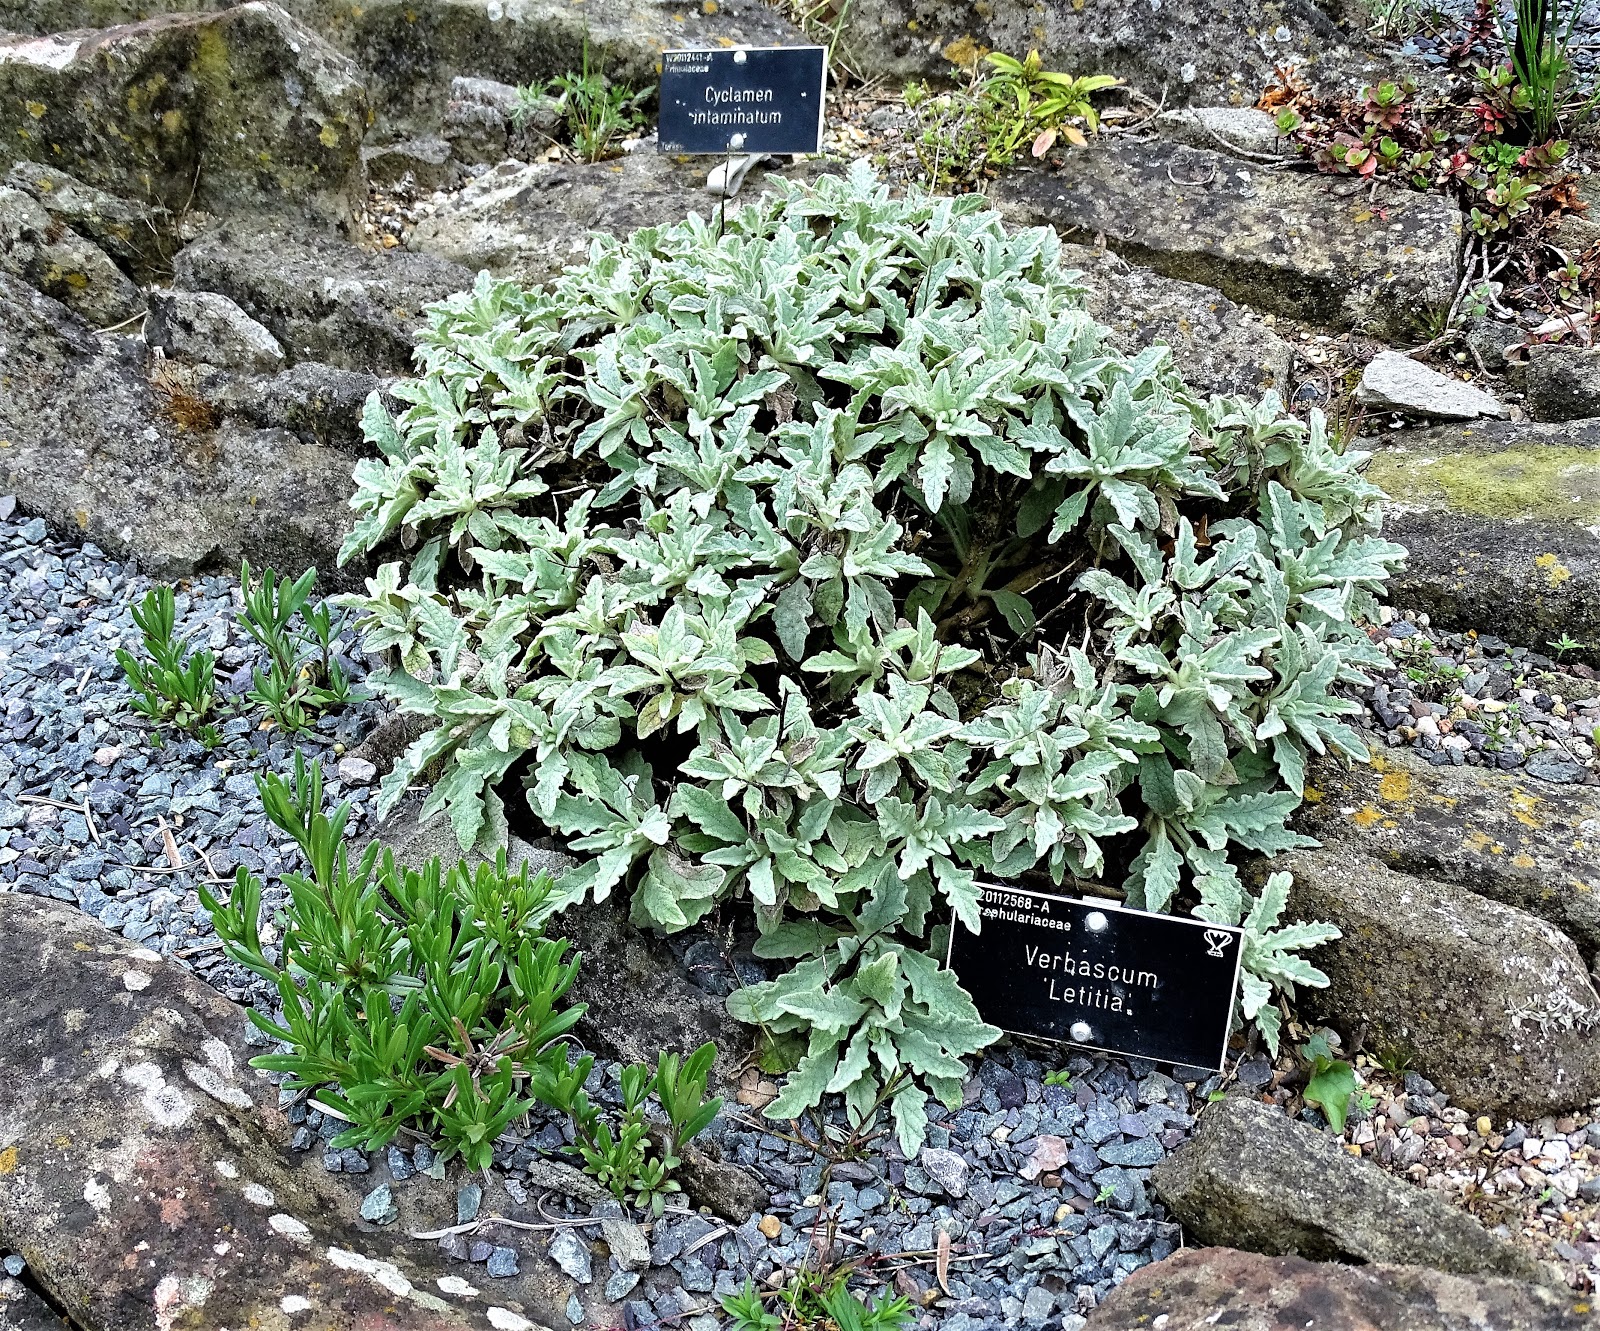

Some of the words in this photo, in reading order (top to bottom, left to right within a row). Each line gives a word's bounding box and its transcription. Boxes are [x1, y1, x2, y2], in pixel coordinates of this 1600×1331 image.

[704, 86, 774, 106] Cyclamen
[692, 108, 783, 125] intaminatum
[1025, 944, 1158, 989] Verbascum
